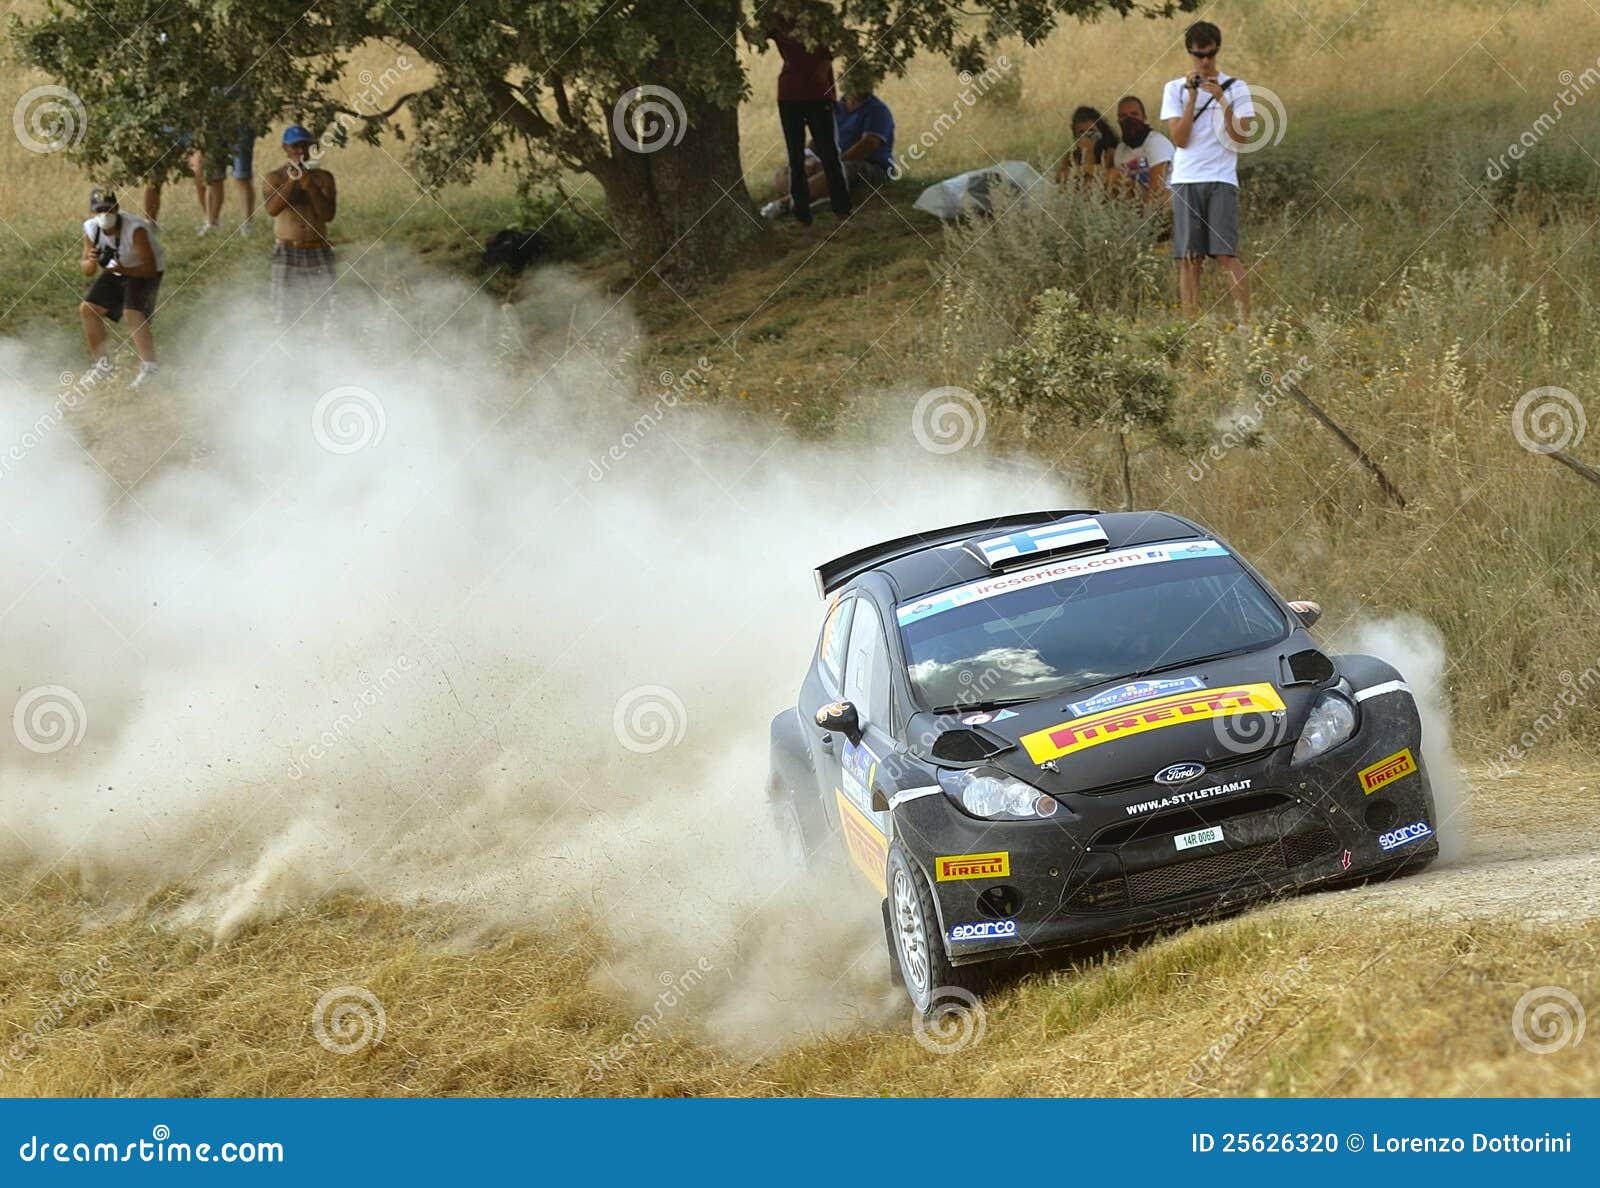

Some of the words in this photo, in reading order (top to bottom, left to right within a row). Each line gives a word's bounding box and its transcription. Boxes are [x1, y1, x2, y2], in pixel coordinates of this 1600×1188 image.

[975, 552, 1141, 596] ircseries.com
[1050, 691, 1253, 749] PIRELLI
[1166, 766, 1195, 781] Ford
[1364, 755, 1411, 789] PIRELLI
[1126, 779, 1252, 815] WWW.A-STYLETEAM.IT
[1379, 822, 1428, 848] sparco
[943, 858, 1003, 877] PIRELLI
[952, 920, 1015, 939] sparco
